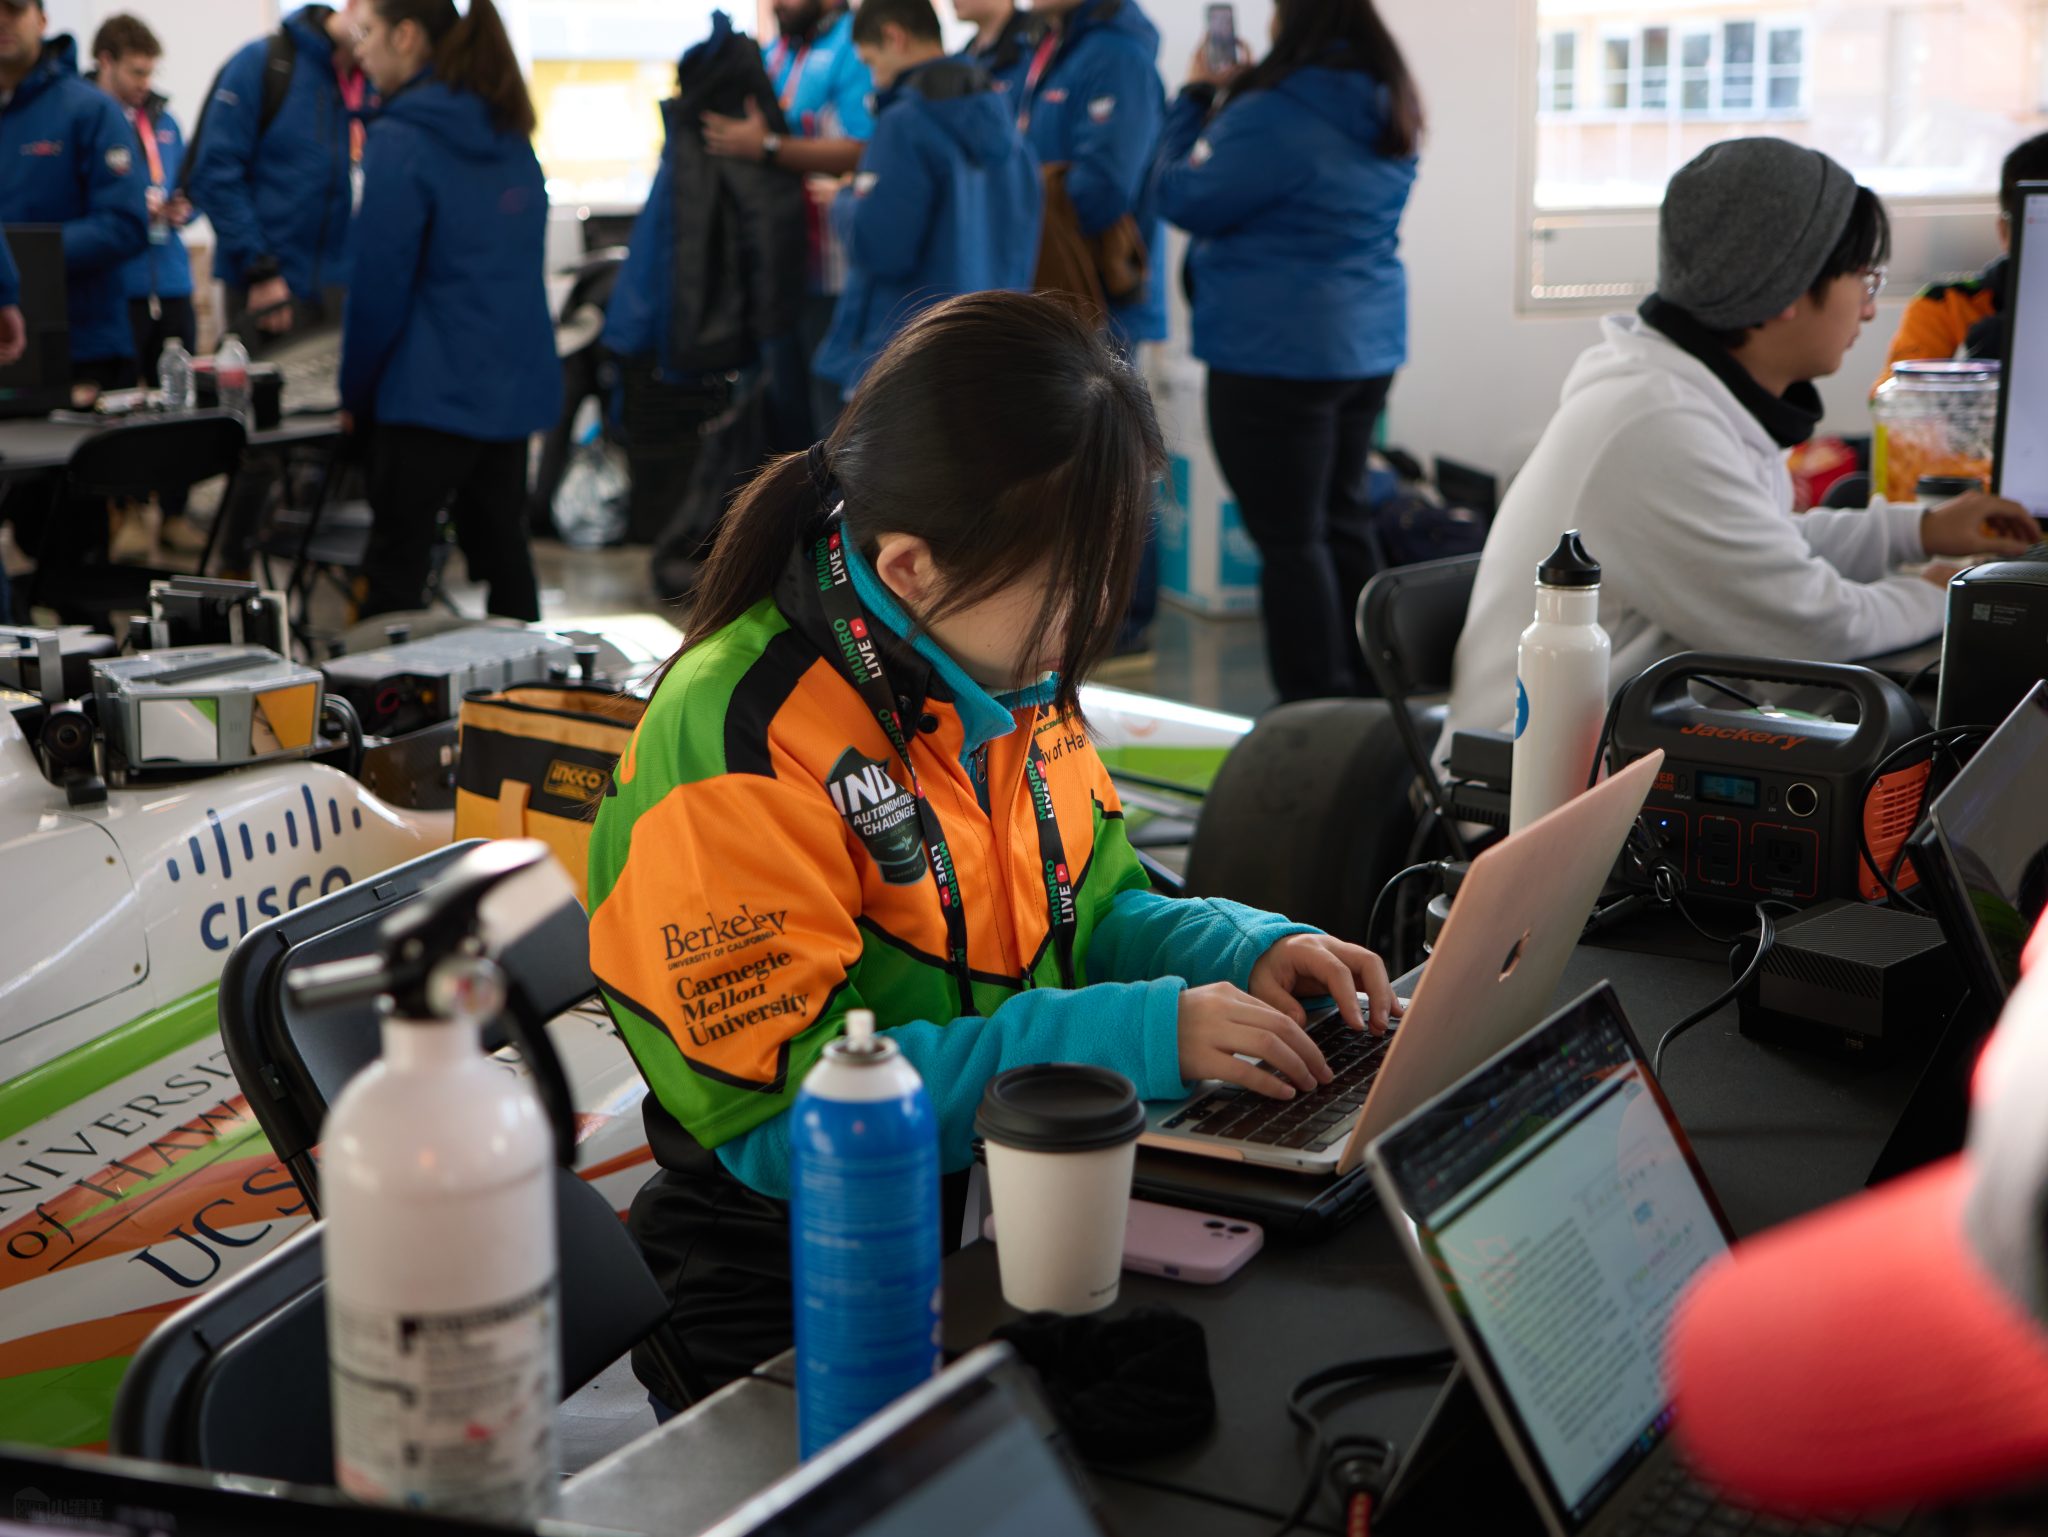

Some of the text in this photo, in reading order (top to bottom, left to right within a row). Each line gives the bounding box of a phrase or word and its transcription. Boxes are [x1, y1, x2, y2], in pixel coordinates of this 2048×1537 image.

[816, 536, 833, 592] MUNRO
[829, 548, 847, 586] LIVE
[833, 617, 870, 685] MUNRO
[857, 639, 882, 679] LIVE
[1052, 738, 1063, 760] of
[1680, 723, 1807, 750] Jackery
[829, 763, 905, 816] IND
[1026, 756, 1047, 821] MUNRO
[1042, 782, 1055, 819] LIVE
[862, 803, 916, 836] CHALLENGE
[931, 844, 948, 885] LIVE
[938, 840, 960, 909] MUNRO
[1045, 859, 1062, 926] MUNRO
[1058, 884, 1075, 924] LIVE
[660, 904, 788, 961] Berkeley
[668, 931, 777, 971] UNIVERSITY OF CALIFORNIA
[676, 951, 793, 1001] Carnegie
[681, 983, 768, 1026] Mellon
[688, 992, 809, 1047] University
[6, 1202, 75, 1260] of
